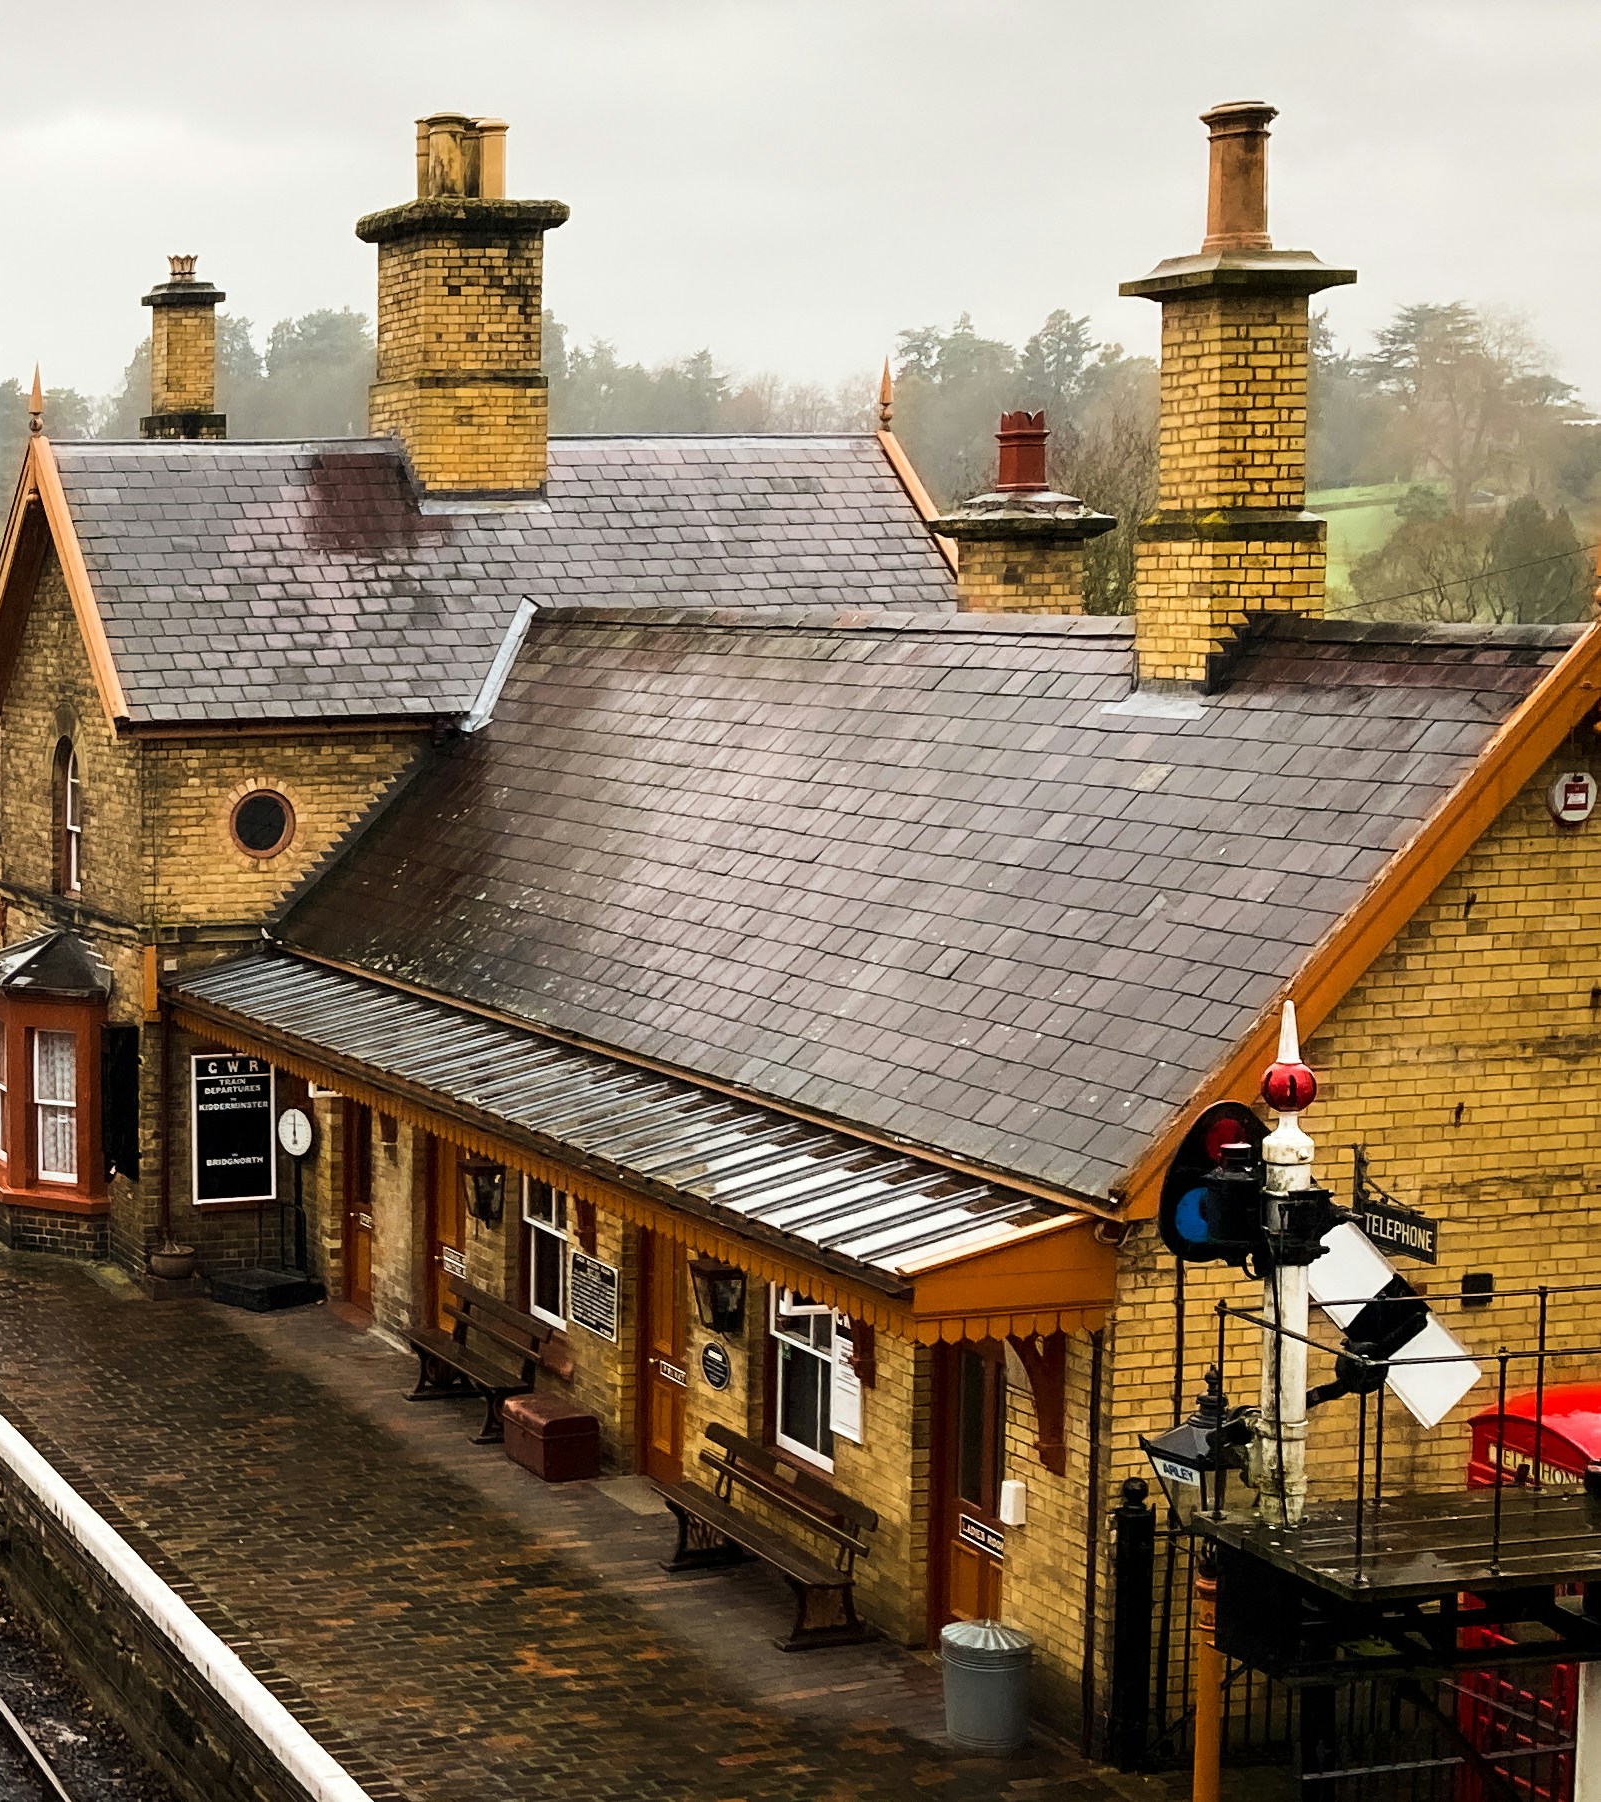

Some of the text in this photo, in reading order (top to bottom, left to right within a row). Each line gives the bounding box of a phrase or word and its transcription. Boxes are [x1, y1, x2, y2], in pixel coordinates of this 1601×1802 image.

[219, 1078, 246, 1086] TRAIN
[204, 1085, 261, 1095] DEPARTURES
[199, 1101, 269, 1111] KIDDERMINSTER
[206, 1157, 264, 1167] BRIDGNORTH
[1364, 1212, 1433, 1253] TELEPHONE
